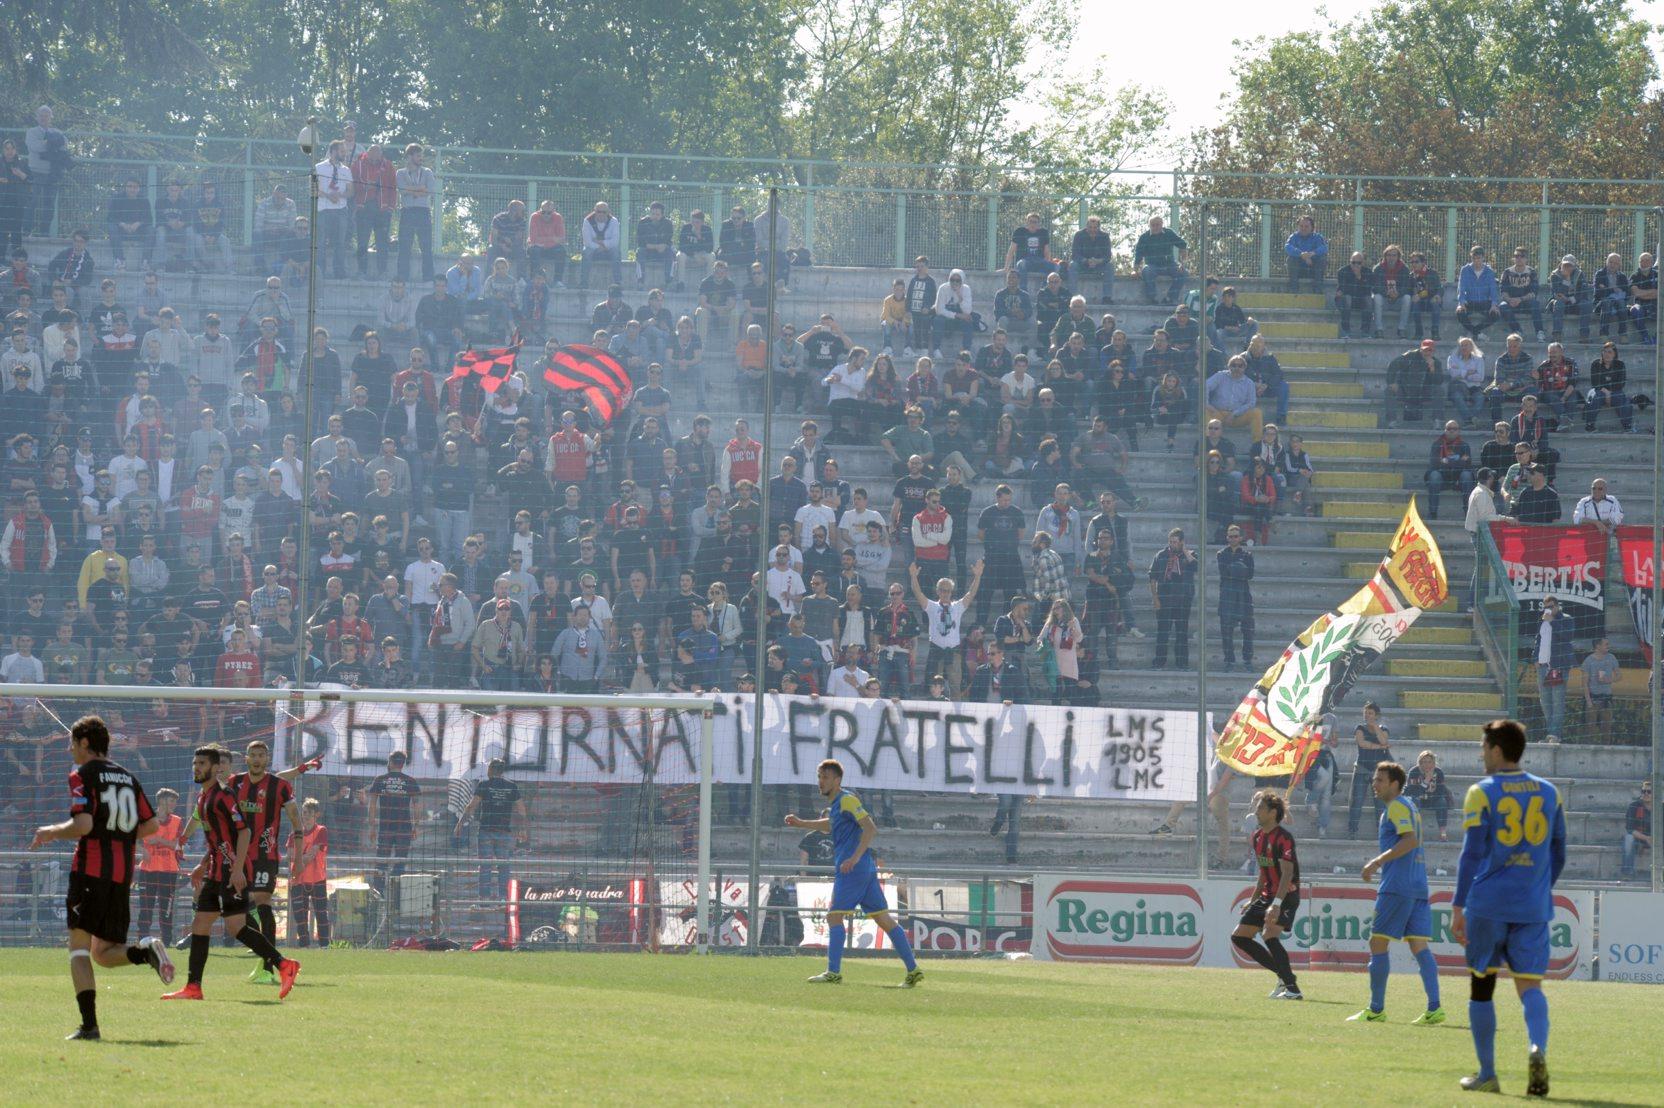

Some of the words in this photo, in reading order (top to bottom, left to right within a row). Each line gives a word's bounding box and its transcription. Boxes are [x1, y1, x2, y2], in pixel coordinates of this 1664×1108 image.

[1107, 714, 1165, 743] LMS
[1104, 743, 1162, 766] 1905
[1111, 767, 1164, 791] LMC
[99, 785, 138, 833] 10
[1496, 796, 1547, 847] 36
[255, 872, 269, 884] 29
[1056, 898, 1198, 942] Regina
[1608, 971, 1653, 982] ENDLESS
